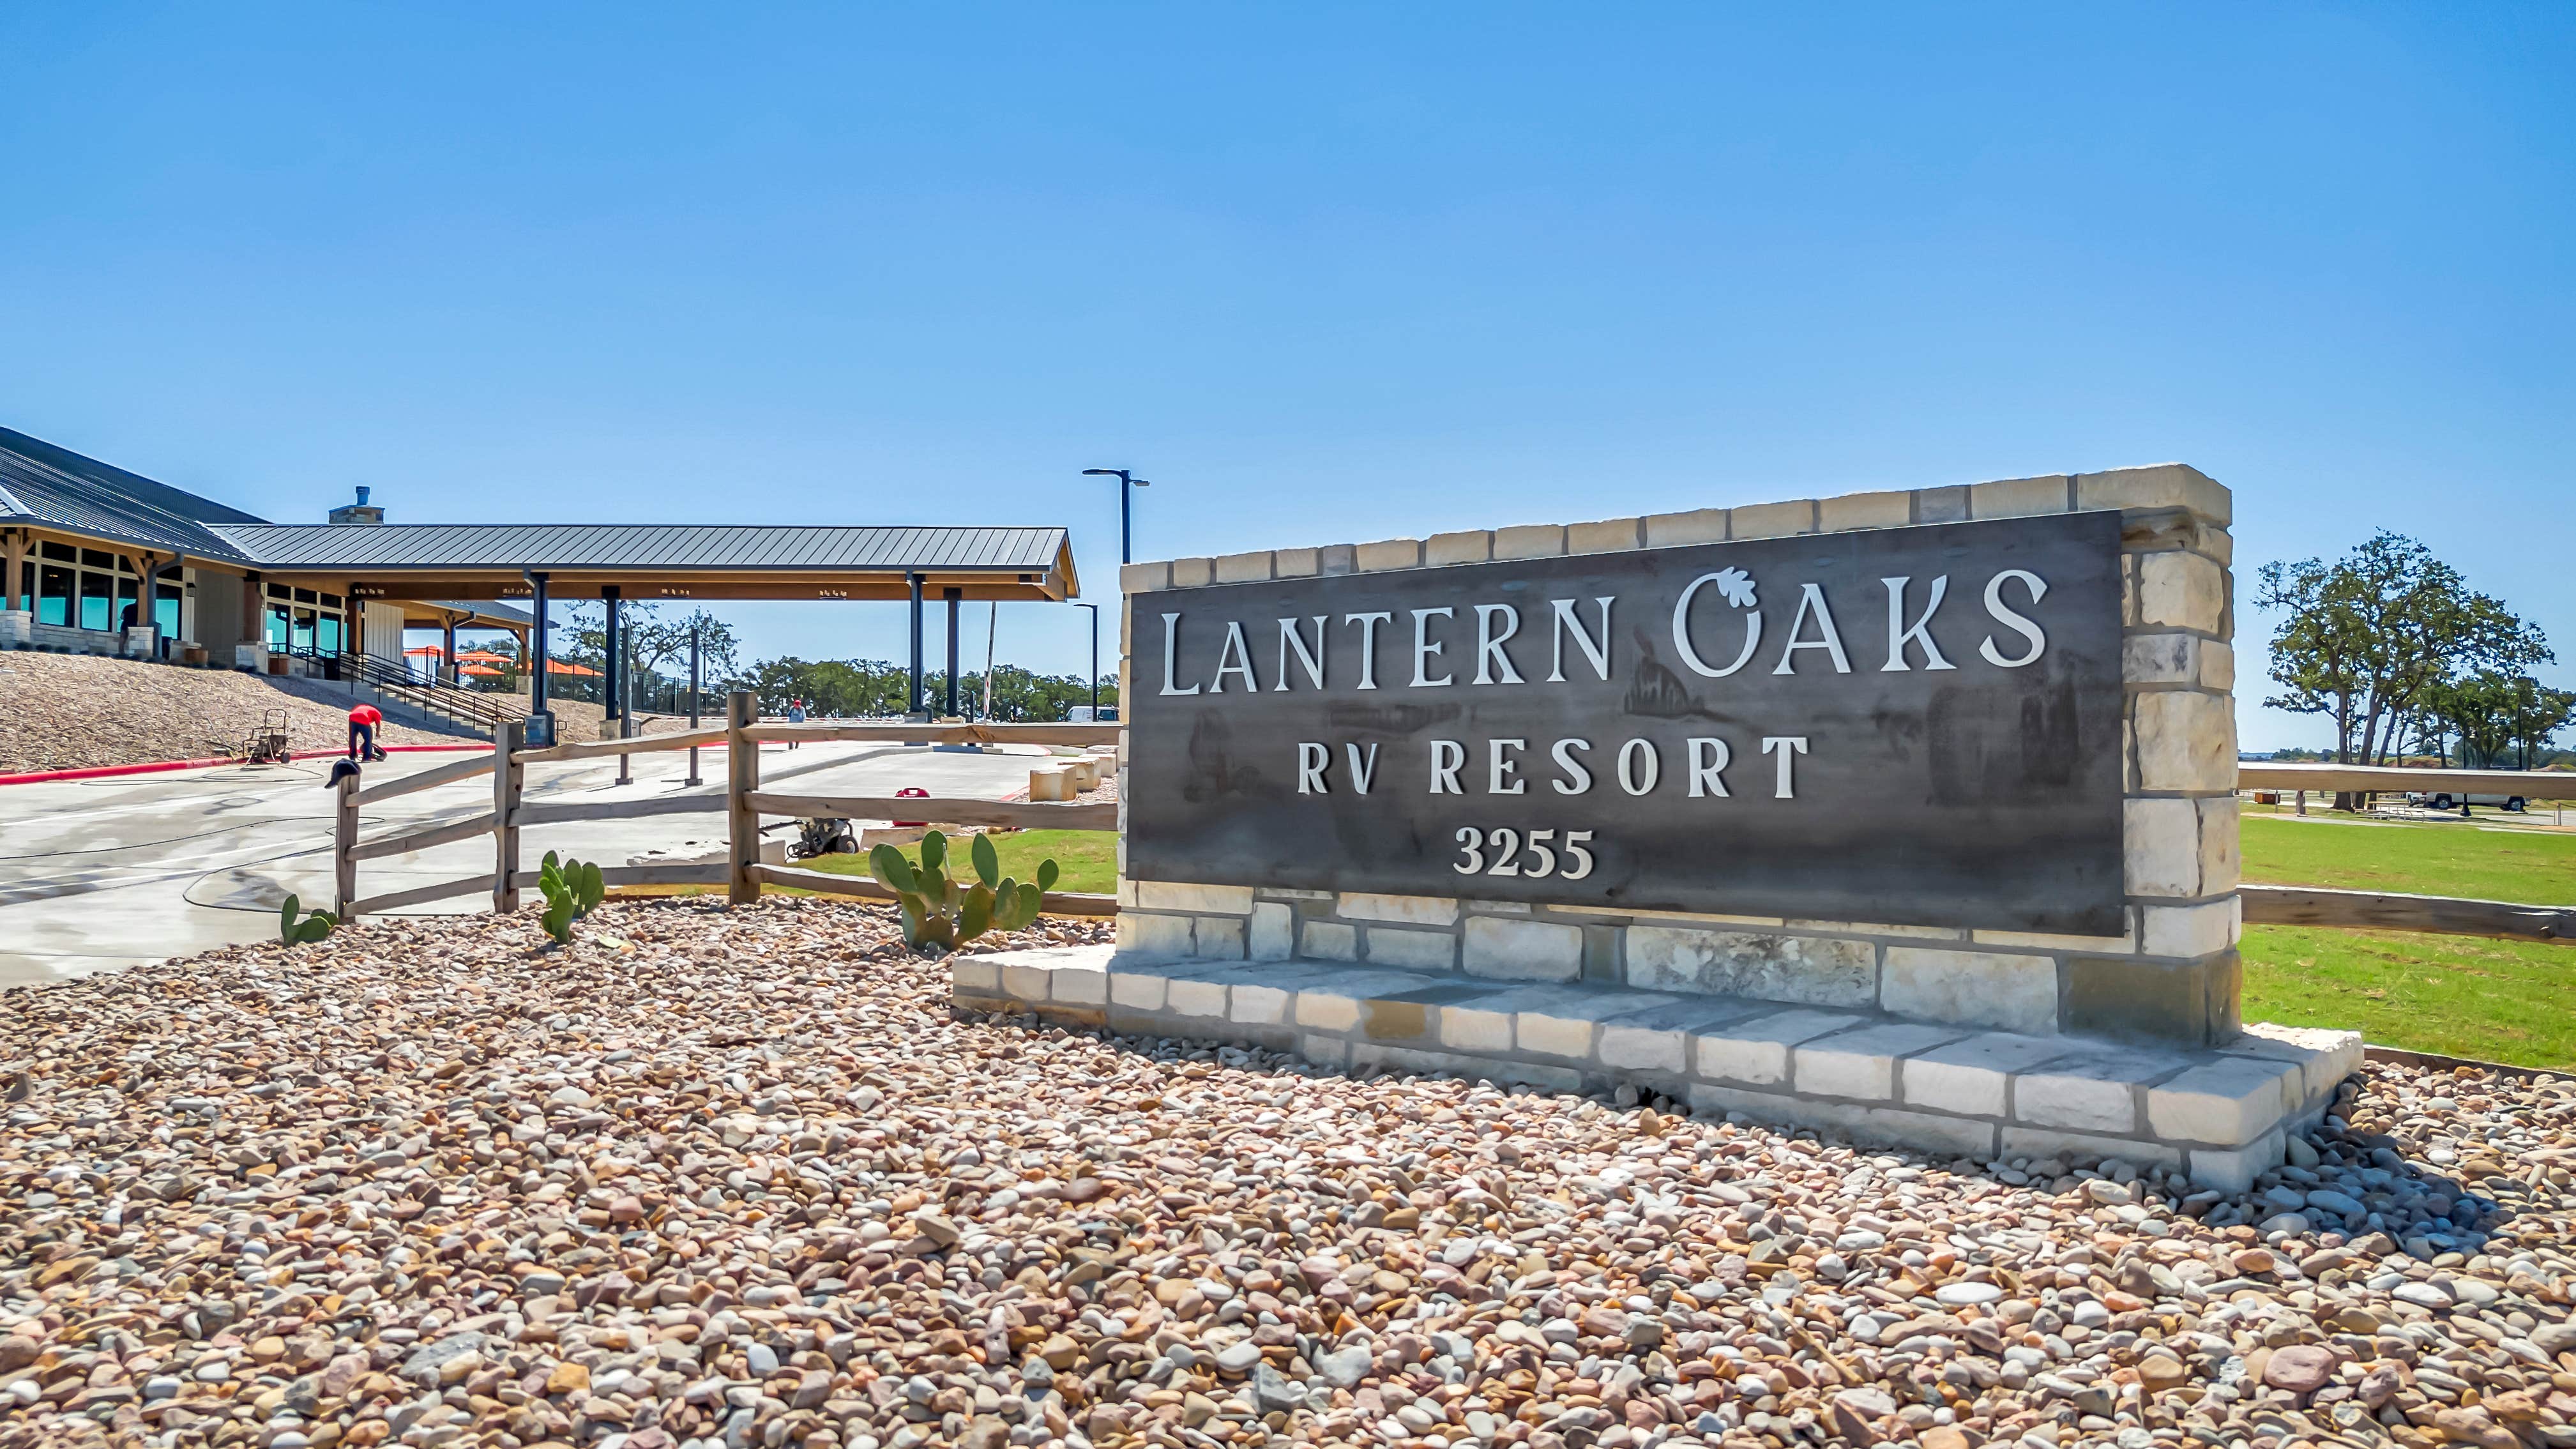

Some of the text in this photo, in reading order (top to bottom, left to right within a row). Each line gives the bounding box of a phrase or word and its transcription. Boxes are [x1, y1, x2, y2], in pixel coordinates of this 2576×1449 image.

[1158, 566, 2048, 695] LANTERN OAKS
[1297, 736, 1808, 799] RV RESORT
[1452, 826, 1594, 881] 3255
